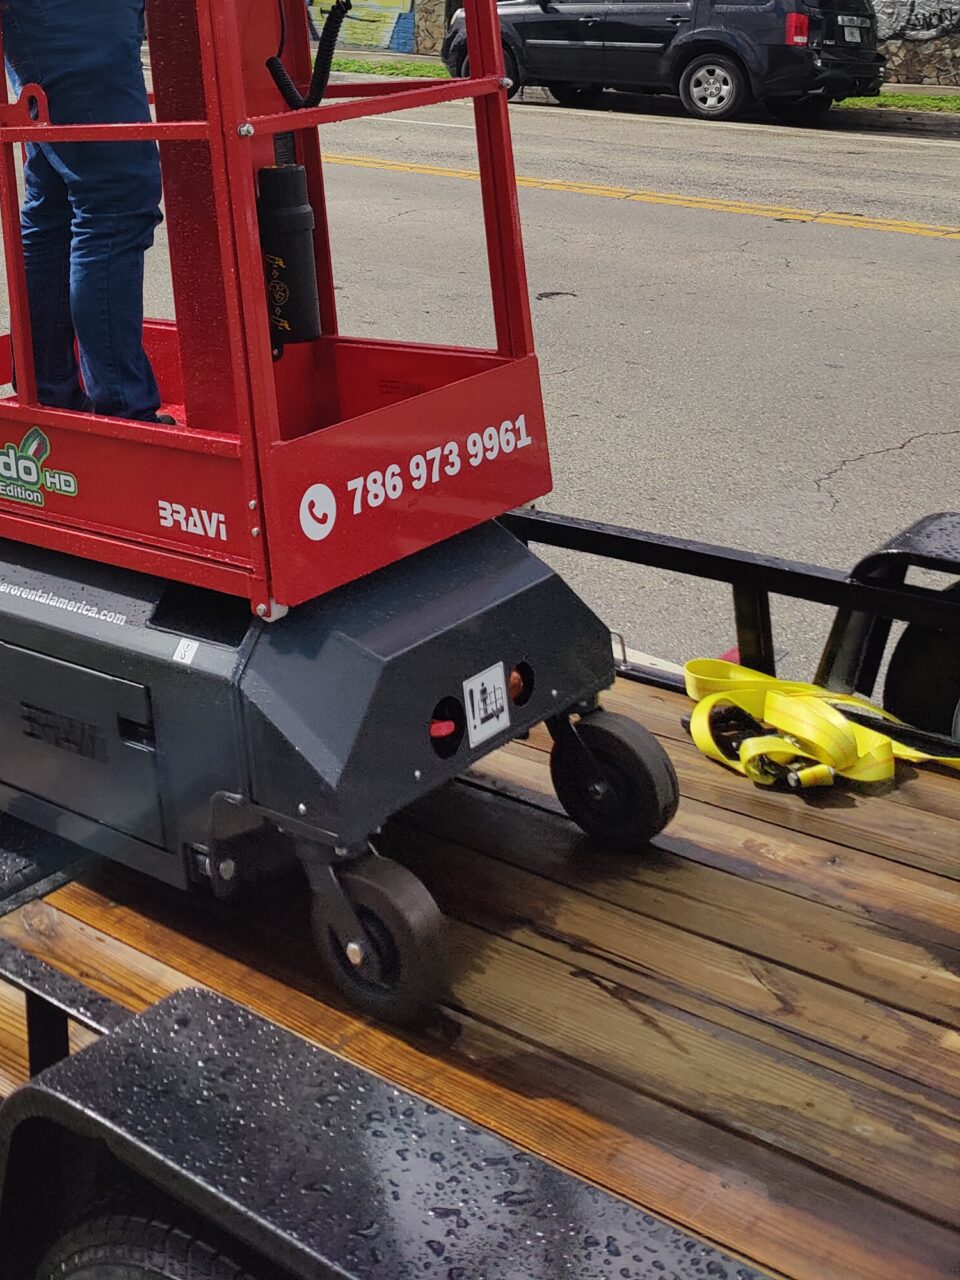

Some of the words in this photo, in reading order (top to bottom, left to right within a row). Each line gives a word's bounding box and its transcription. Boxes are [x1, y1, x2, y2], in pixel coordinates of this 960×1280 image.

[44, 471, 76, 492] HD
[347, 463, 404, 516] 786
[409, 441, 461, 491] 973
[466, 413, 533, 467] 9961
